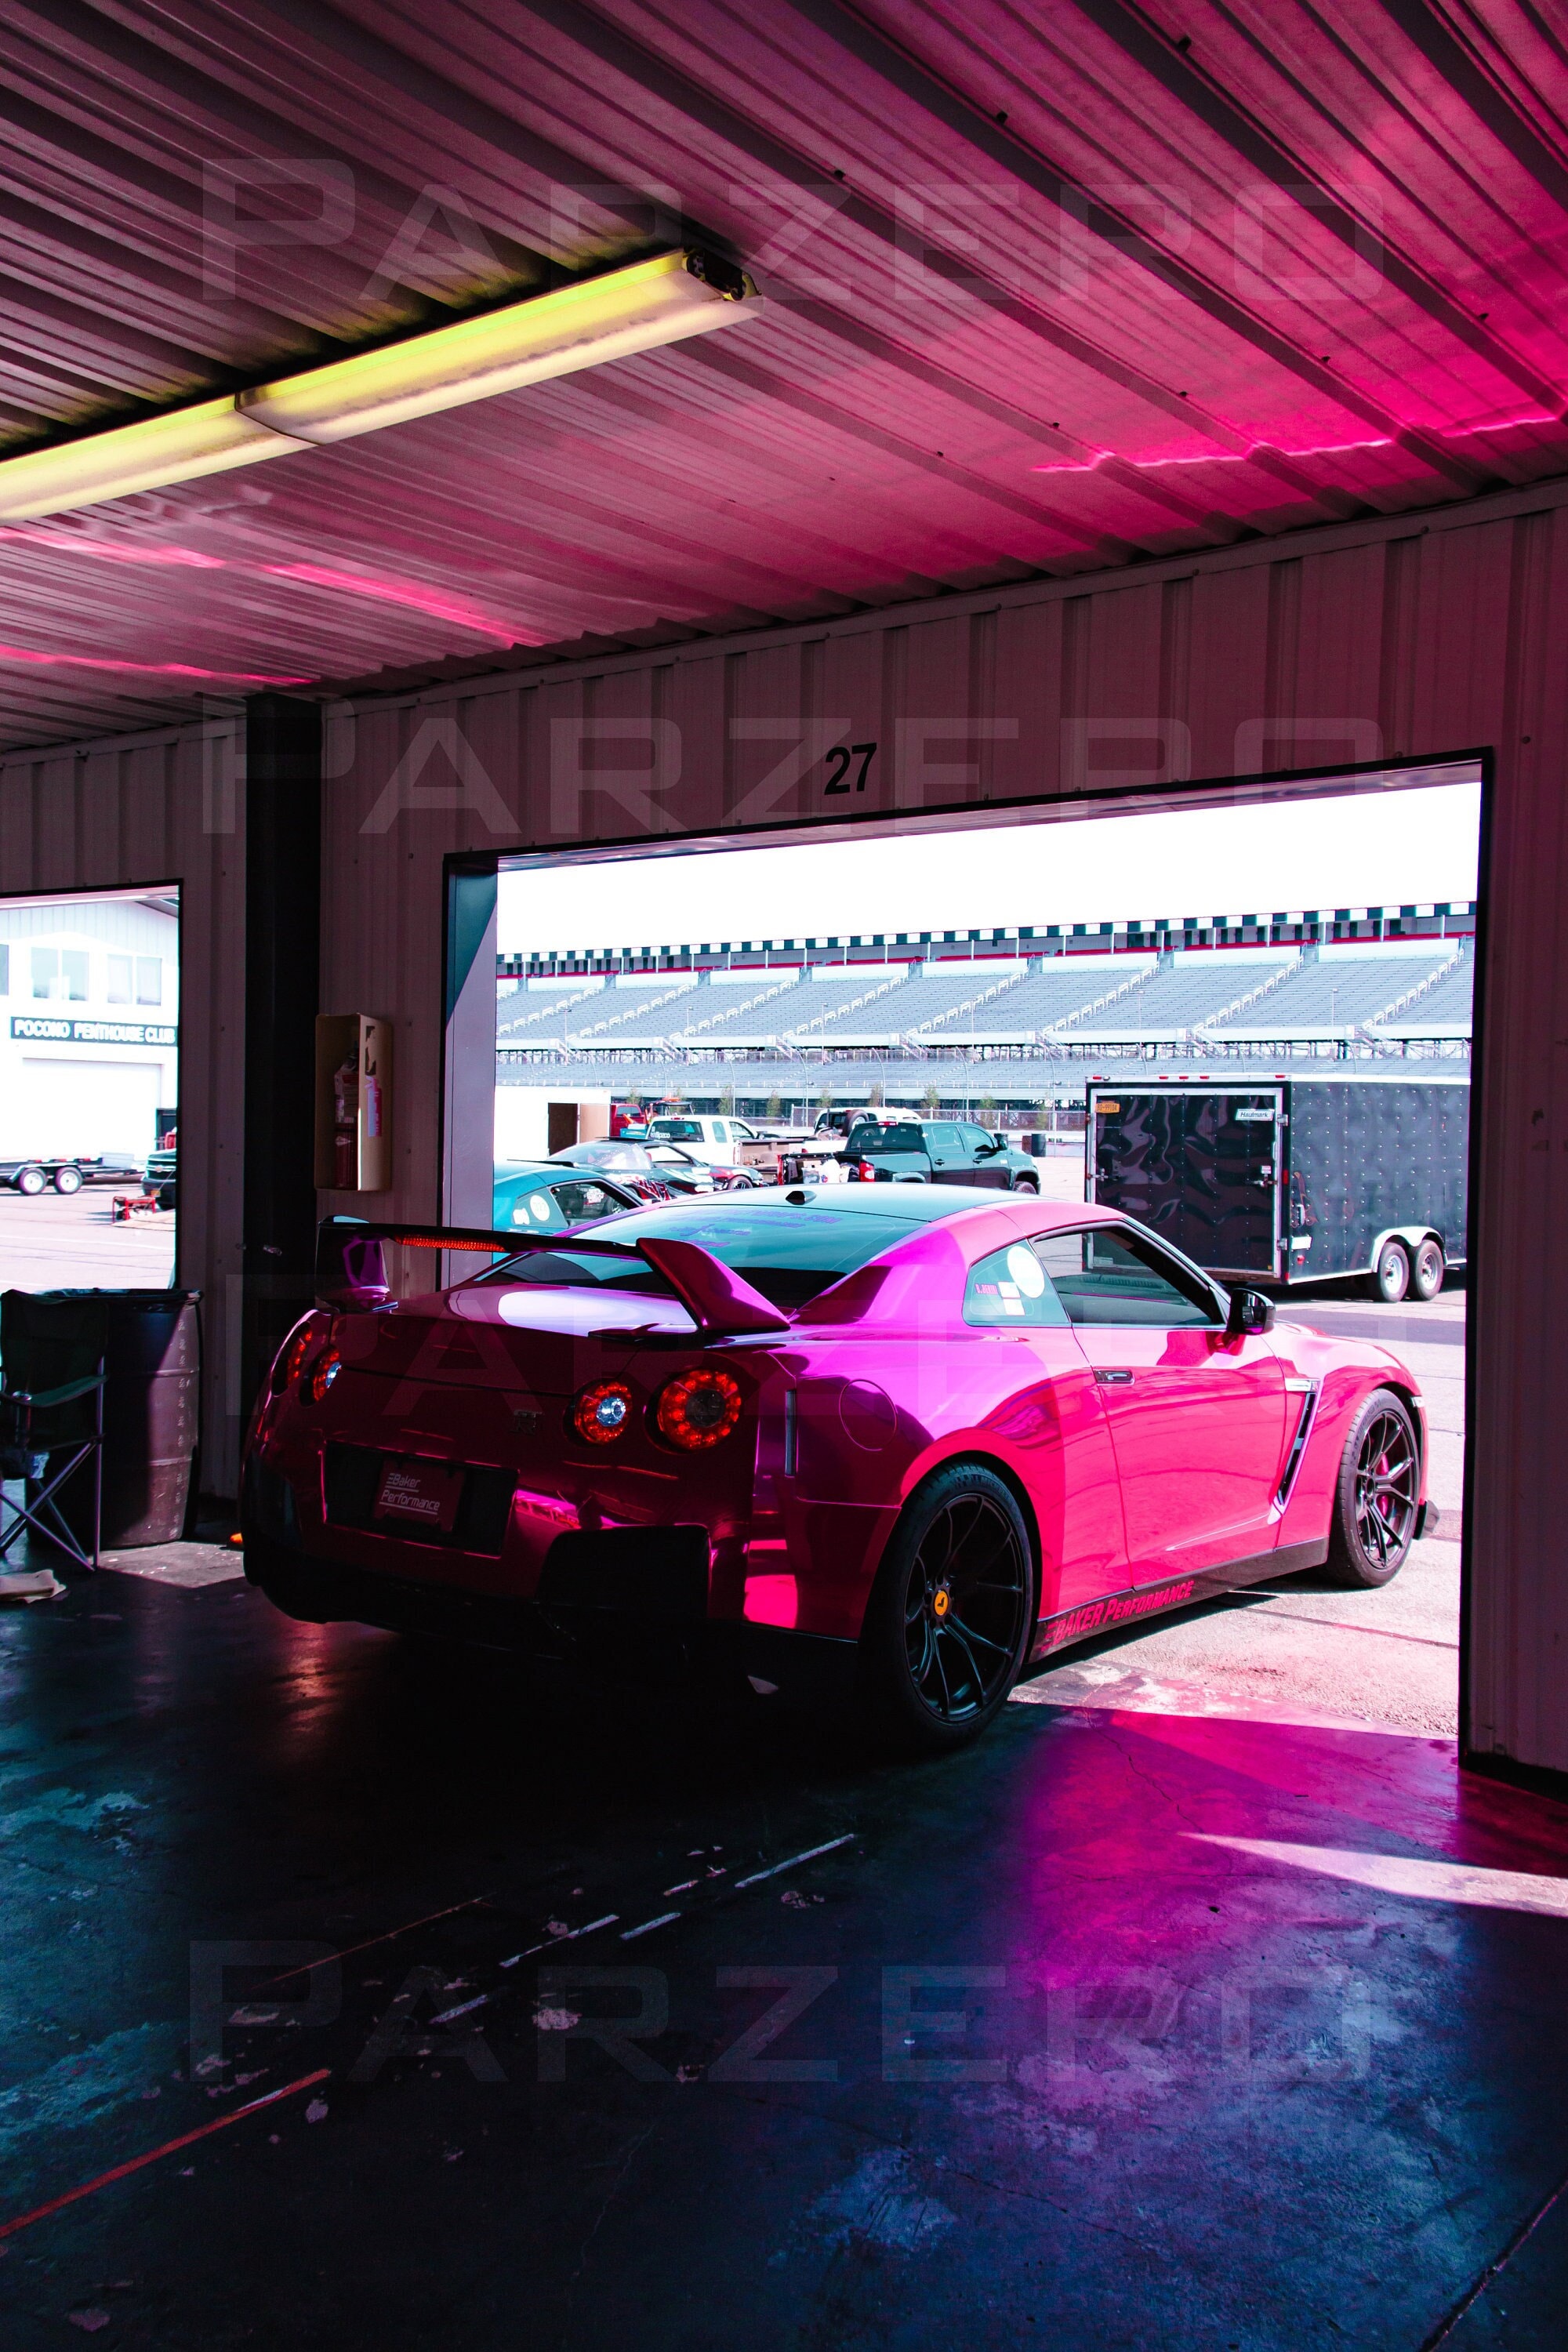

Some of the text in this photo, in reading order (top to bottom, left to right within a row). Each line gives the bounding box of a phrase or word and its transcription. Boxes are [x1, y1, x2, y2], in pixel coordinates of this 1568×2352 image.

[824, 742, 877, 795] 27
[14, 1020, 175, 1044] POCONO PENTHOUSE CLUB
[392, 1474, 421, 1488] Baker
[380, 1490, 441, 1511] Performance
[1052, 1580, 1195, 1647] BAKER PERFORMANCE
